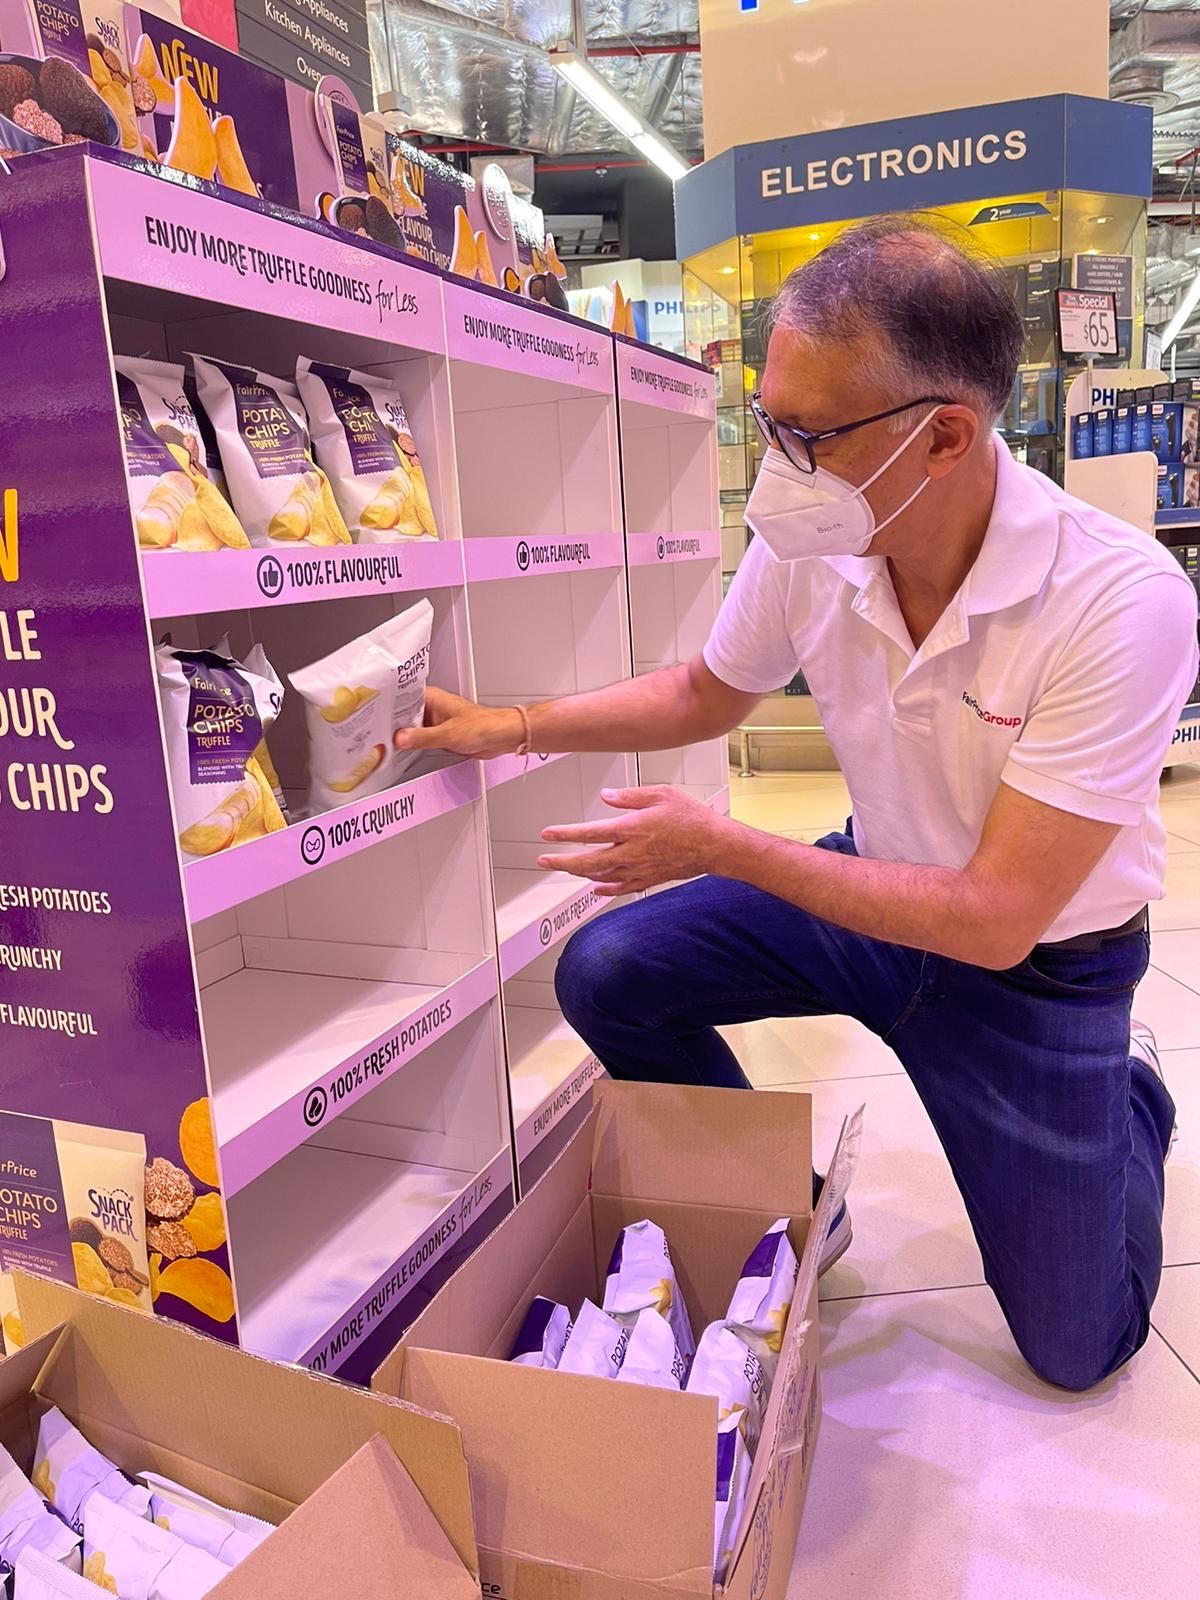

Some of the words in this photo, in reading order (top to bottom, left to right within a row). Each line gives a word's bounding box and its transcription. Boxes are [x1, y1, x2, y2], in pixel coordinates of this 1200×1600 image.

[36, 1, 80, 28] POTATO
[39, 14, 71, 37] CHIPS
[265, 3, 302, 37] Kitchen
[304, 25, 351, 67] Appliances
[159, 38, 219, 105] NEW
[296, 56, 325, 83] Oven
[760, 130, 1028, 199] ELECTRONICS
[989, 208, 999, 221] 2
[145, 215, 198, 256] ENJOY
[200, 233, 248, 277] MORE
[248, 247, 308, 288] TRUFFLE
[309, 266, 373, 305] GOODNESS
[375, 279, 395, 323] for
[395, 285, 419, 315] Less
[654, 299, 720, 315] PHILIPS
[1079, 295, 1109, 310] Special
[464, 315, 488, 340] ENJOY
[488, 323, 511, 349] MORE
[511, 327, 541, 354] TRUFFLE
[541, 336, 575, 362] GOODNESS
[586, 346, 600, 367] Less
[630, 366, 645, 385] ENJOY
[645, 370, 658, 392] MORE
[658, 373, 674, 393] TRUFFLE
[673, 376, 694, 398] GOODNESS
[242, 407, 287, 423] POTAT
[244, 422, 291, 440] CHIPS
[249, 439, 281, 450] TRUFFLE
[353, 433, 378, 444] TRUFFLE
[531, 546, 549, 565] 100%
[549, 543, 591, 564] FLAVOURFUL
[664, 540, 678, 554] 100%
[677, 538, 700, 556] FLAVOURFUL
[286, 562, 324, 588] 100%
[325, 555, 403, 587] FLAVOURFUL
[398, 659, 426, 684] CHIPS
[194, 703, 255, 719] POTATO
[193, 719, 244, 734] CHIPS
[196, 736, 232, 749] TRUFFLE
[8, 762, 114, 814] CHIPS
[328, 814, 362, 849] 100%
[361, 794, 416, 834] CRUNCHY
[31, 886, 112, 914] POTATOES
[553, 910, 570, 933] 100%
[570, 896, 591, 921] FRESH
[0, 1003, 98, 1037] FLAVOURFUL
[330, 1065, 363, 1104] 100%
[363, 1035, 400, 1078] FRESH
[400, 999, 453, 1052] POTATOES
[533, 1109, 554, 1137] ENJOY
[553, 1085, 573, 1112] MORE
[571, 1064, 595, 1095] TRUFFLE
[88, 1188, 133, 1219] SNACK
[101, 1211, 138, 1242] PACK
[329, 1316, 364, 1361] MORE
[364, 1273, 409, 1325] TRUFFLE
[408, 1214, 457, 1278] GOODNESS
[473, 1175, 493, 1209] Less
